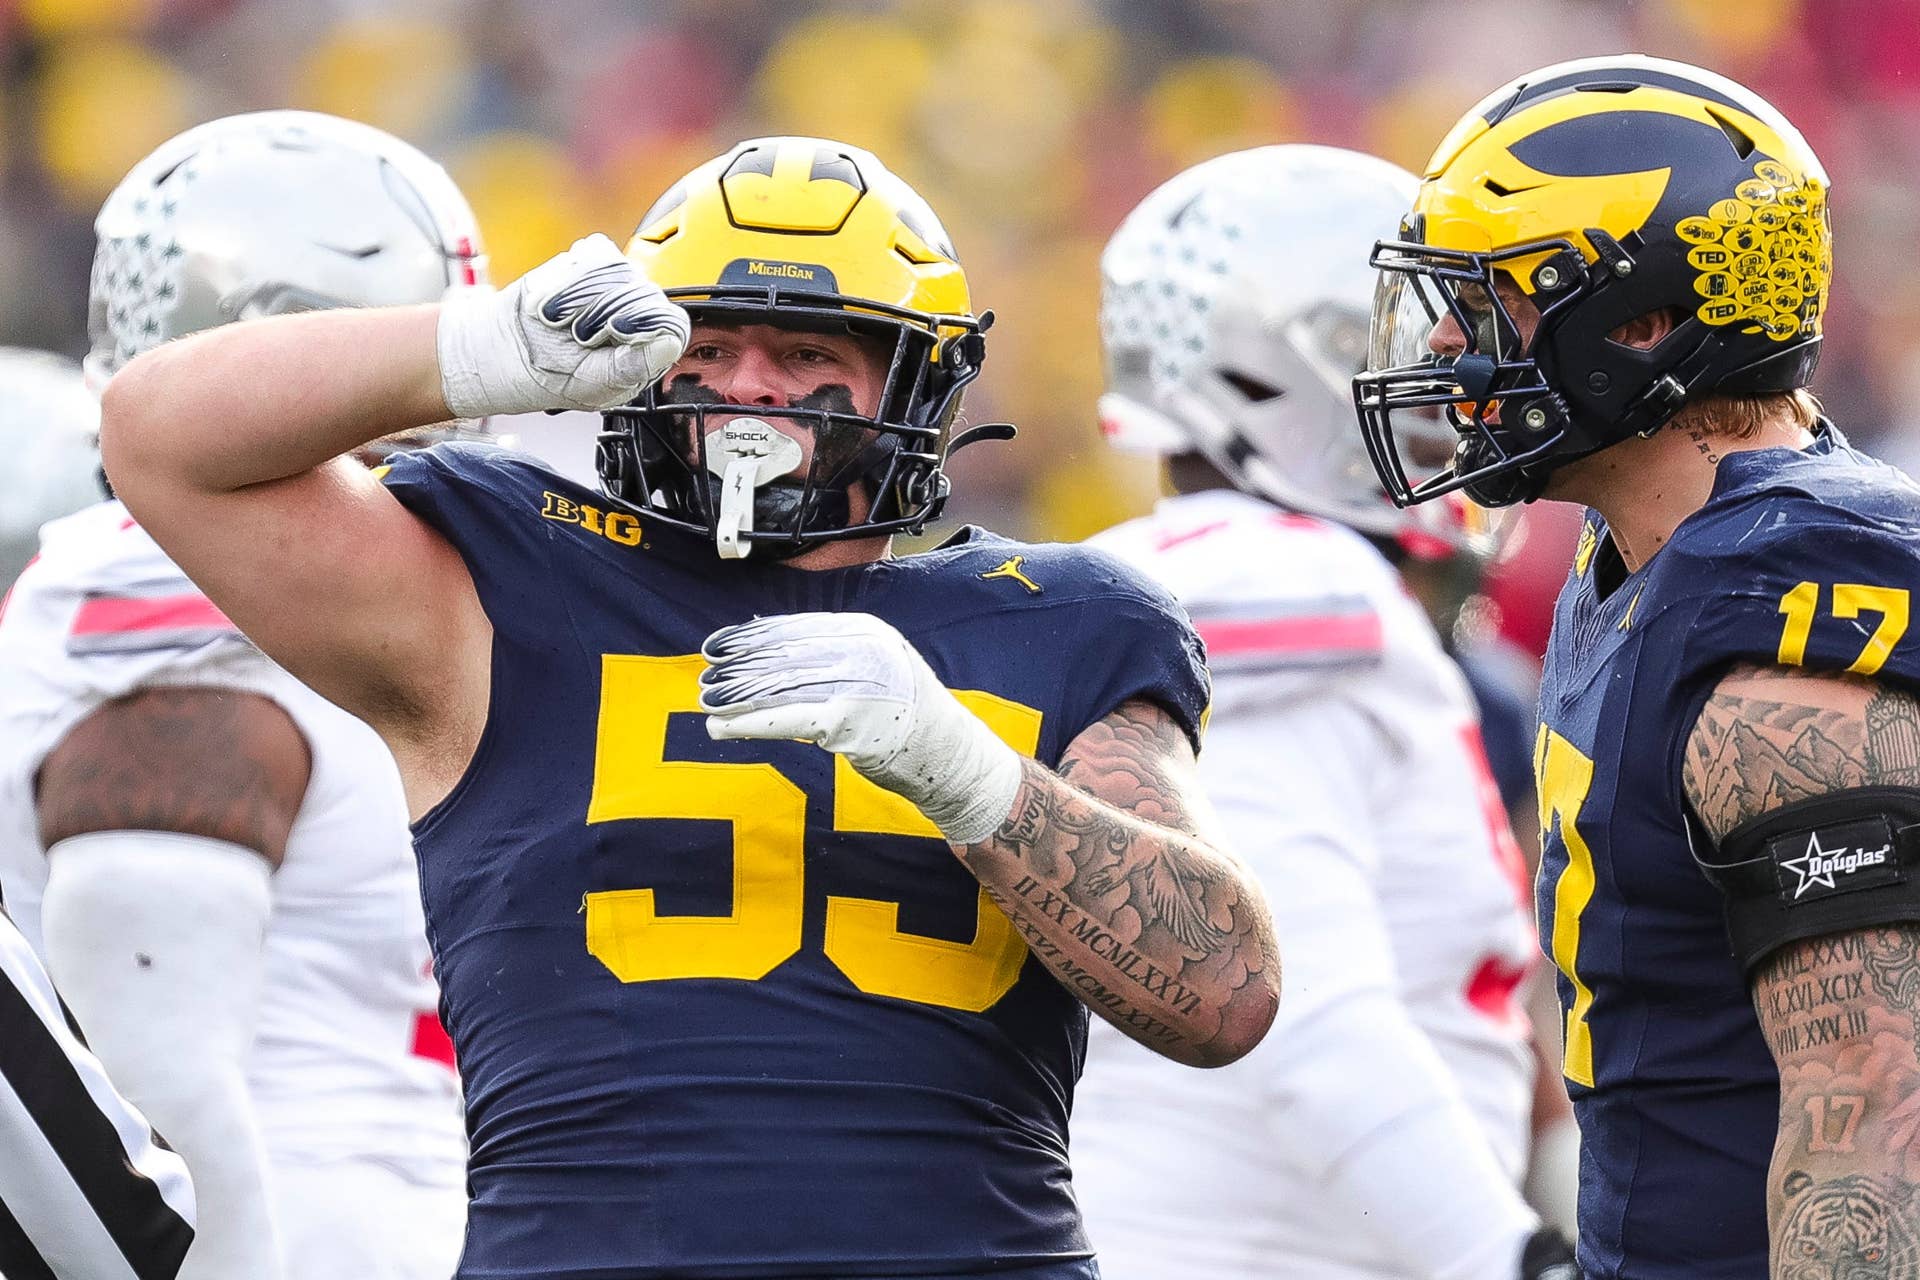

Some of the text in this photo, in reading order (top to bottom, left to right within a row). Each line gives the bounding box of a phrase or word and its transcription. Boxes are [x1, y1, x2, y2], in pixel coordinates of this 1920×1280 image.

[747, 261, 814, 281] MICHIGAN
[1695, 251, 1727, 264] TED
[1705, 303, 1737, 319] TED
[725, 431, 769, 442] SHOCK
[1777, 581, 1909, 676] 17
[585, 653, 1043, 1013] 55
[1808, 846, 1886, 877] Douglas
[1034, 893, 1076, 927] XX
[1069, 918, 1203, 1016] MCMLXXVI
[1804, 1095, 1866, 1153] 17
